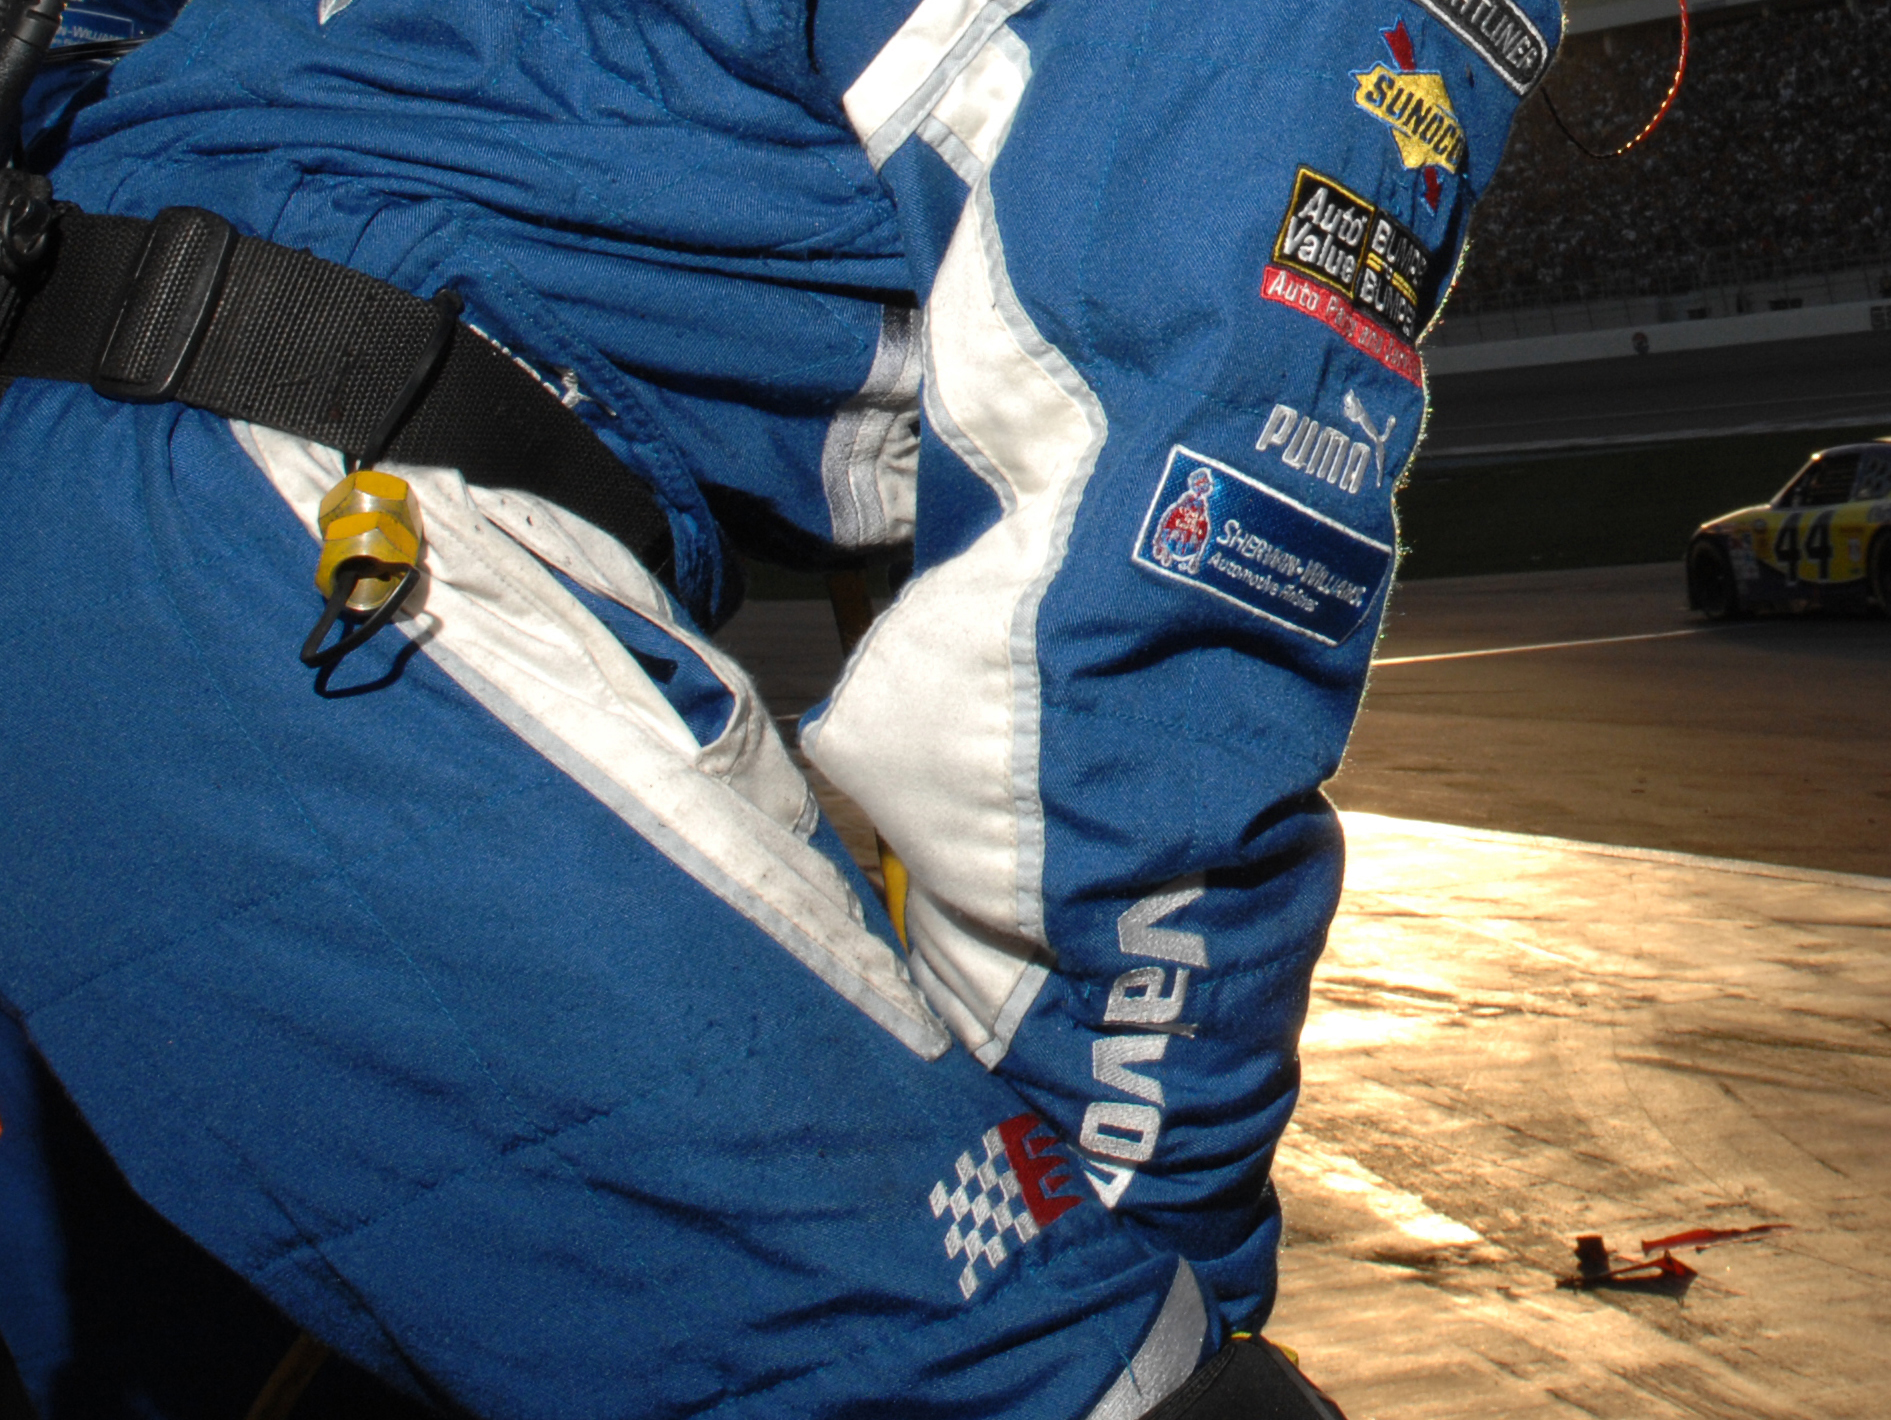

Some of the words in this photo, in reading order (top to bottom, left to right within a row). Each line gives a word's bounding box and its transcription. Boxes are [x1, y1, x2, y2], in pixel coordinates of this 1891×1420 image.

[1364, 72, 1466, 166] SUNOCO
[1282, 215, 1357, 284] Value
[1299, 186, 1366, 247] Auto
[1268, 270, 1320, 311] Auto
[1256, 403, 1371, 494] PUMA
[1774, 510, 1835, 588] 44
